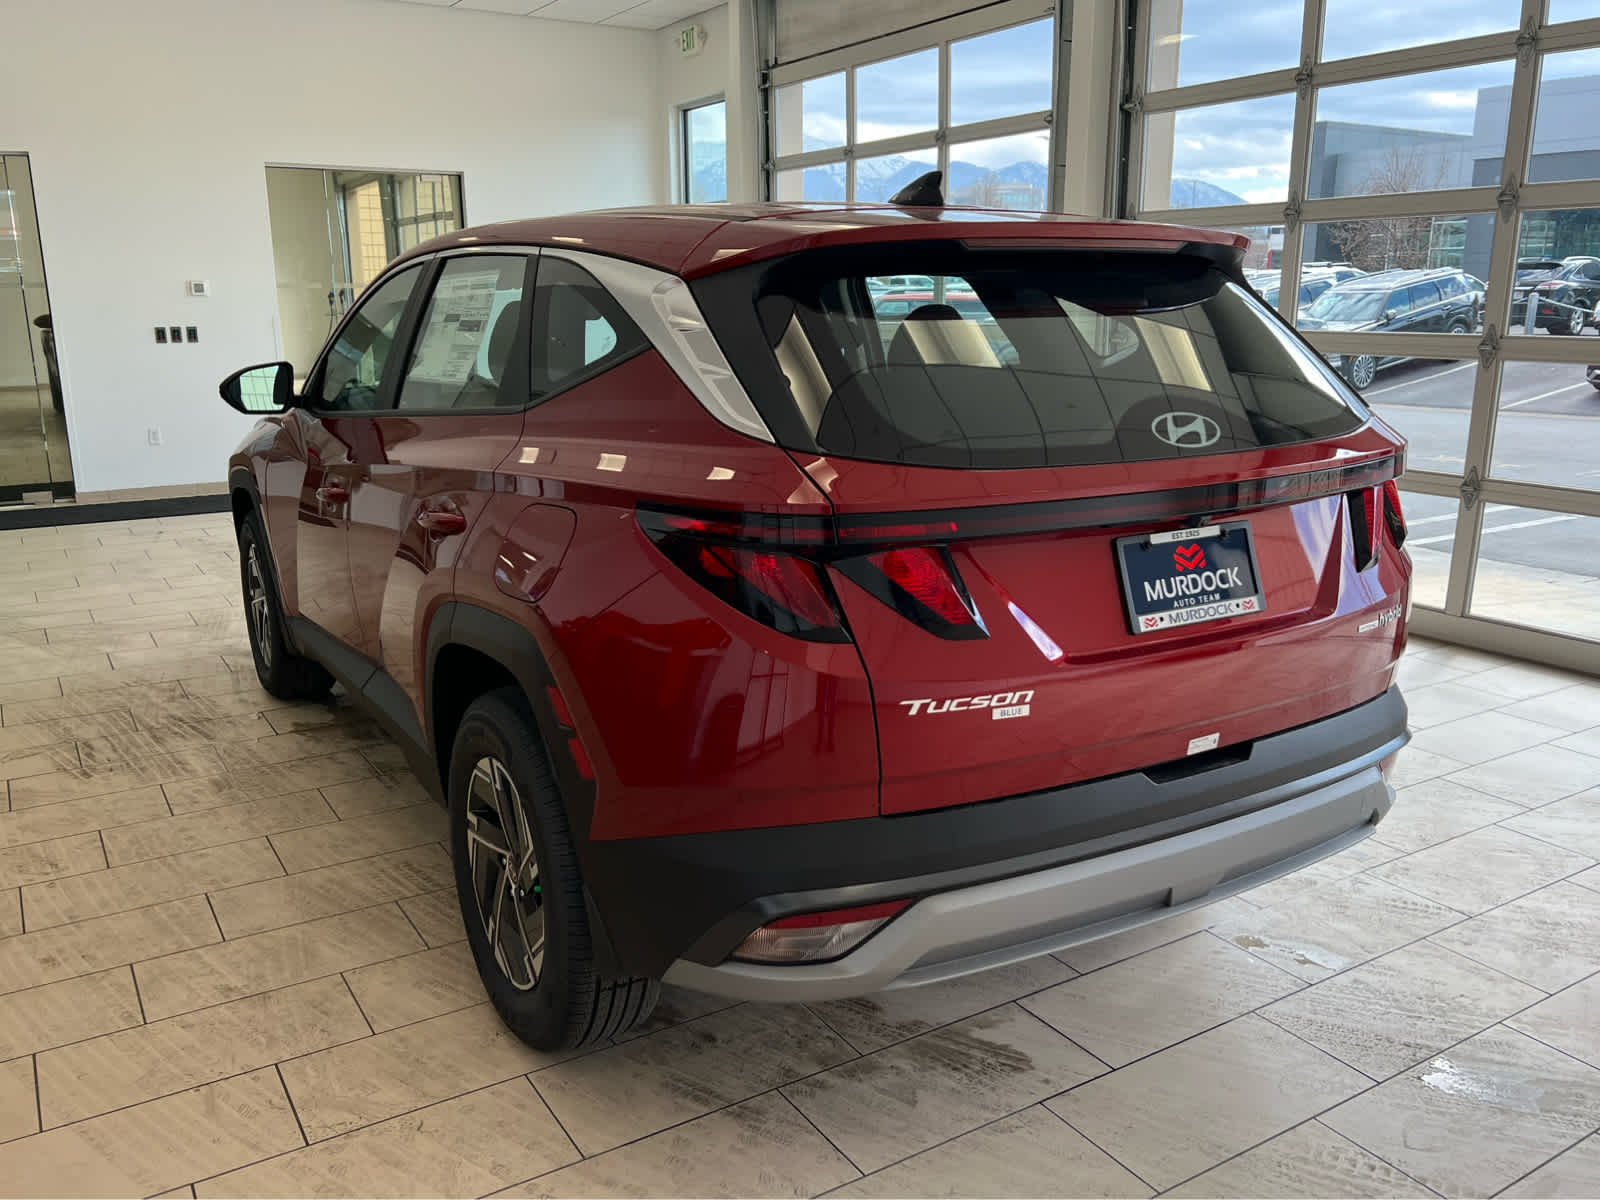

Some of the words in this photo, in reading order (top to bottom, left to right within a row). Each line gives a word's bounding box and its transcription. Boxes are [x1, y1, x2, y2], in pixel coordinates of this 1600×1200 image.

[682, 26, 695, 52] EXIT
[1143, 566, 1243, 602] MURDOCK
[1173, 597, 1196, 608] AUTO
[1198, 592, 1221, 604] TEAM
[1168, 602, 1233, 625] MURDOCK
[1000, 707, 1023, 717] BLUE
